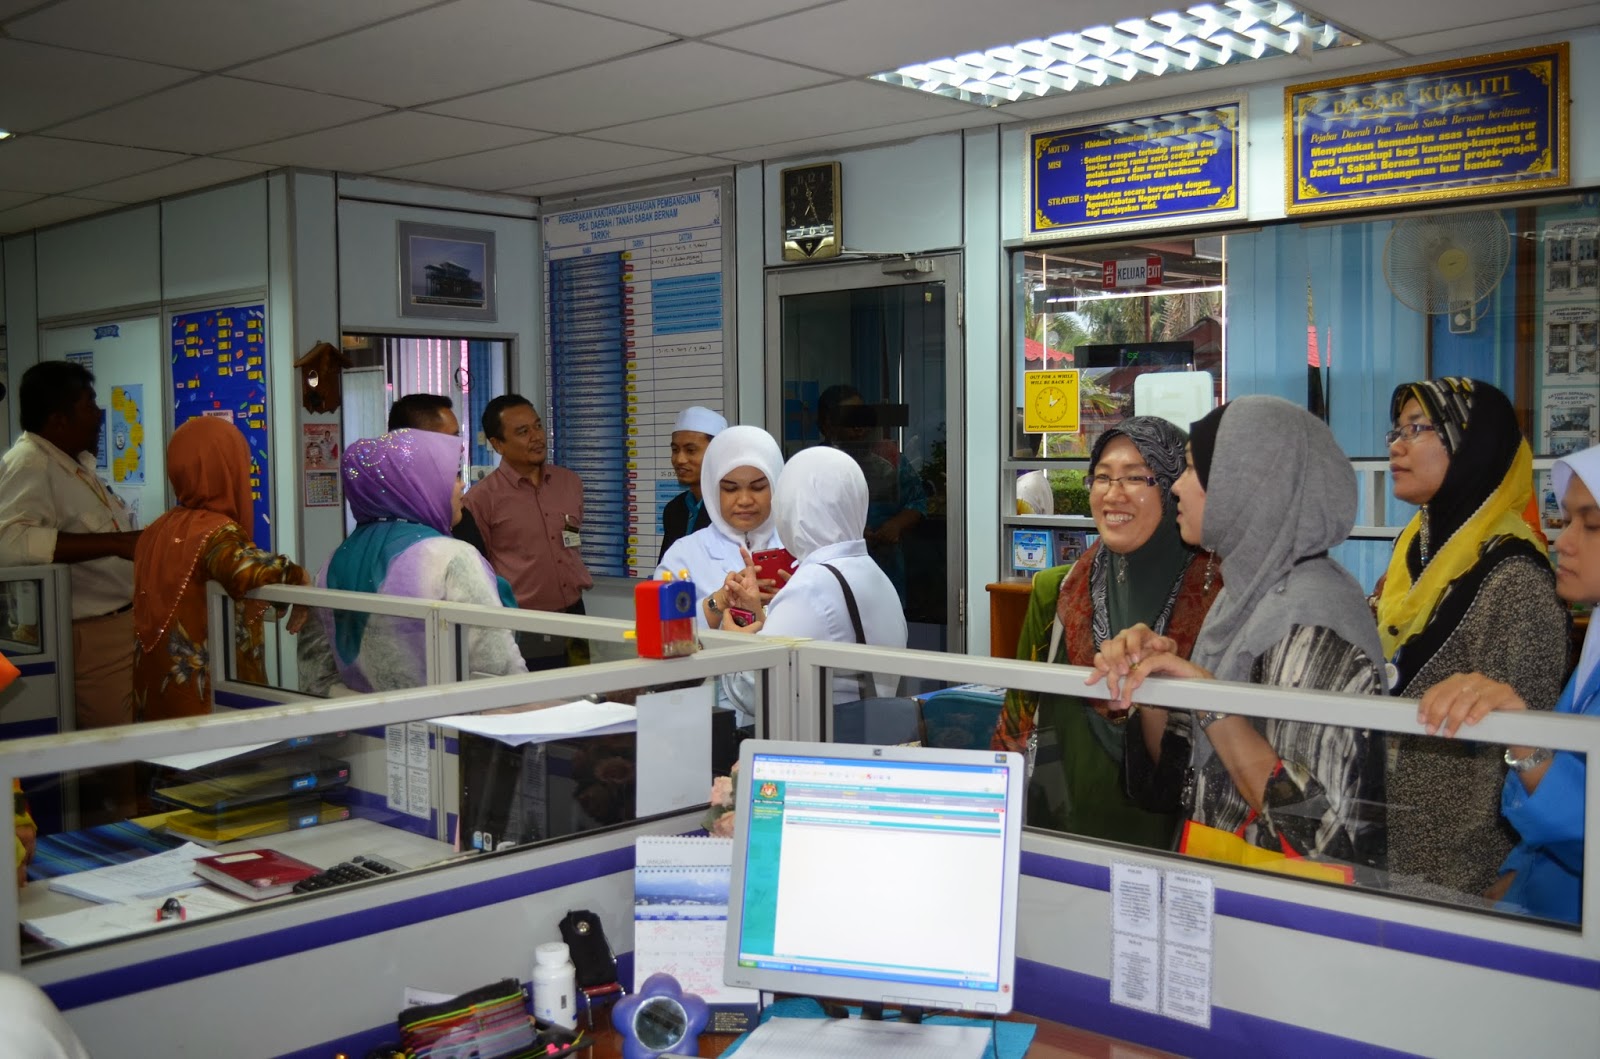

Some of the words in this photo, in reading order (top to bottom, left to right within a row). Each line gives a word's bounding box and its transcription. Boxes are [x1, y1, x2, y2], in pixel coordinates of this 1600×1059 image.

[1333, 92, 1404, 115] DASAR
[1420, 76, 1510, 102] KUALITI
[1341, 127, 1370, 139] Daerah
[1374, 125, 1391, 135] Dan
[1395, 120, 1419, 132] Tanah
[1422, 116, 1448, 128] Sabak
[1452, 114, 1485, 124] Bernam
[1048, 144, 1070, 154] MOTTO
[1084, 138, 1112, 149] Khidmat
[1310, 142, 1374, 157] Menyediakan
[1377, 134, 1434, 149] kemudahan
[1438, 131, 1462, 141] asas
[1466, 122, 1537, 137] infrastruktur
[1312, 158, 1335, 169] yang
[1338, 149, 1392, 164] mencukupi
[1396, 146, 1418, 158] bagi
[1421, 134, 1521, 154] kampung-kampung
[1525, 130, 1536, 141] di
[1048, 160, 1062, 170] MISI
[1084, 154, 1112, 164] Sentiasa
[1114, 152, 1136, 162] respon
[1138, 146, 1168, 158] terhadap
[1170, 142, 1198, 153] masalah
[1200, 140, 1214, 148] dan
[1086, 162, 1107, 172] isu-isu
[1109, 160, 1128, 170] orang
[1130, 156, 1148, 166] ramai
[1150, 154, 1168, 163] serta
[1170, 150, 1194, 160] sedaya
[1196, 148, 1218, 158] upaya
[1310, 166, 1344, 178] Daerah
[1346, 162, 1377, 174] Sabak
[1380, 158, 1420, 170] Bernam
[1424, 152, 1461, 165] melalui
[1464, 143, 1538, 161] projek-projek
[1086, 168, 1130, 180] melaksanakan
[1146, 158, 1208, 172] menyelesaikannya
[1086, 178, 1109, 188] dengan
[1111, 176, 1126, 184] cara
[1128, 172, 1152, 182] efisyen
[1154, 170, 1166, 179] dan
[1168, 166, 1202, 177] berkesan.
[1340, 174, 1363, 185] kecil
[1366, 166, 1436, 184] pembangunan
[1440, 164, 1460, 174] luar
[1464, 159, 1504, 171] bandar.
[1048, 195, 1080, 206] STRATEGI
[1084, 190, 1122, 202] Pendekatan
[1124, 188, 1146, 198] secara
[1148, 183, 1183, 194] bersepadu
[1185, 180, 1210, 190] dengan
[1086, 196, 1136, 210] Agensi/Jabatan
[1138, 193, 1160, 204] Negeri
[1162, 192, 1176, 200] dan
[1177, 186, 1221, 198] Persekutuan
[558, 211, 593, 224] PERGERAKAN
[593, 205, 627, 218] KAKITANGAN
[628, 200, 656, 214] BAHAGIAN
[656, 193, 700, 210] PEMBANGUNAN
[590, 218, 612, 230] DAERAH
[616, 215, 634, 226] TANAH
[634, 212, 653, 224] SABAK
[654, 208, 678, 220] BERNAM
[1086, 208, 1100, 218] bagi
[1102, 204, 1140, 216] menjayakan
[1142, 202, 1158, 212] misi.
[800, 225, 805, 236] 7
[809, 226, 816, 236] 6
[1104, 264, 1114, 284] 出口
[1118, 266, 1146, 280] KELUAR
[1148, 264, 1162, 278] EXIT
